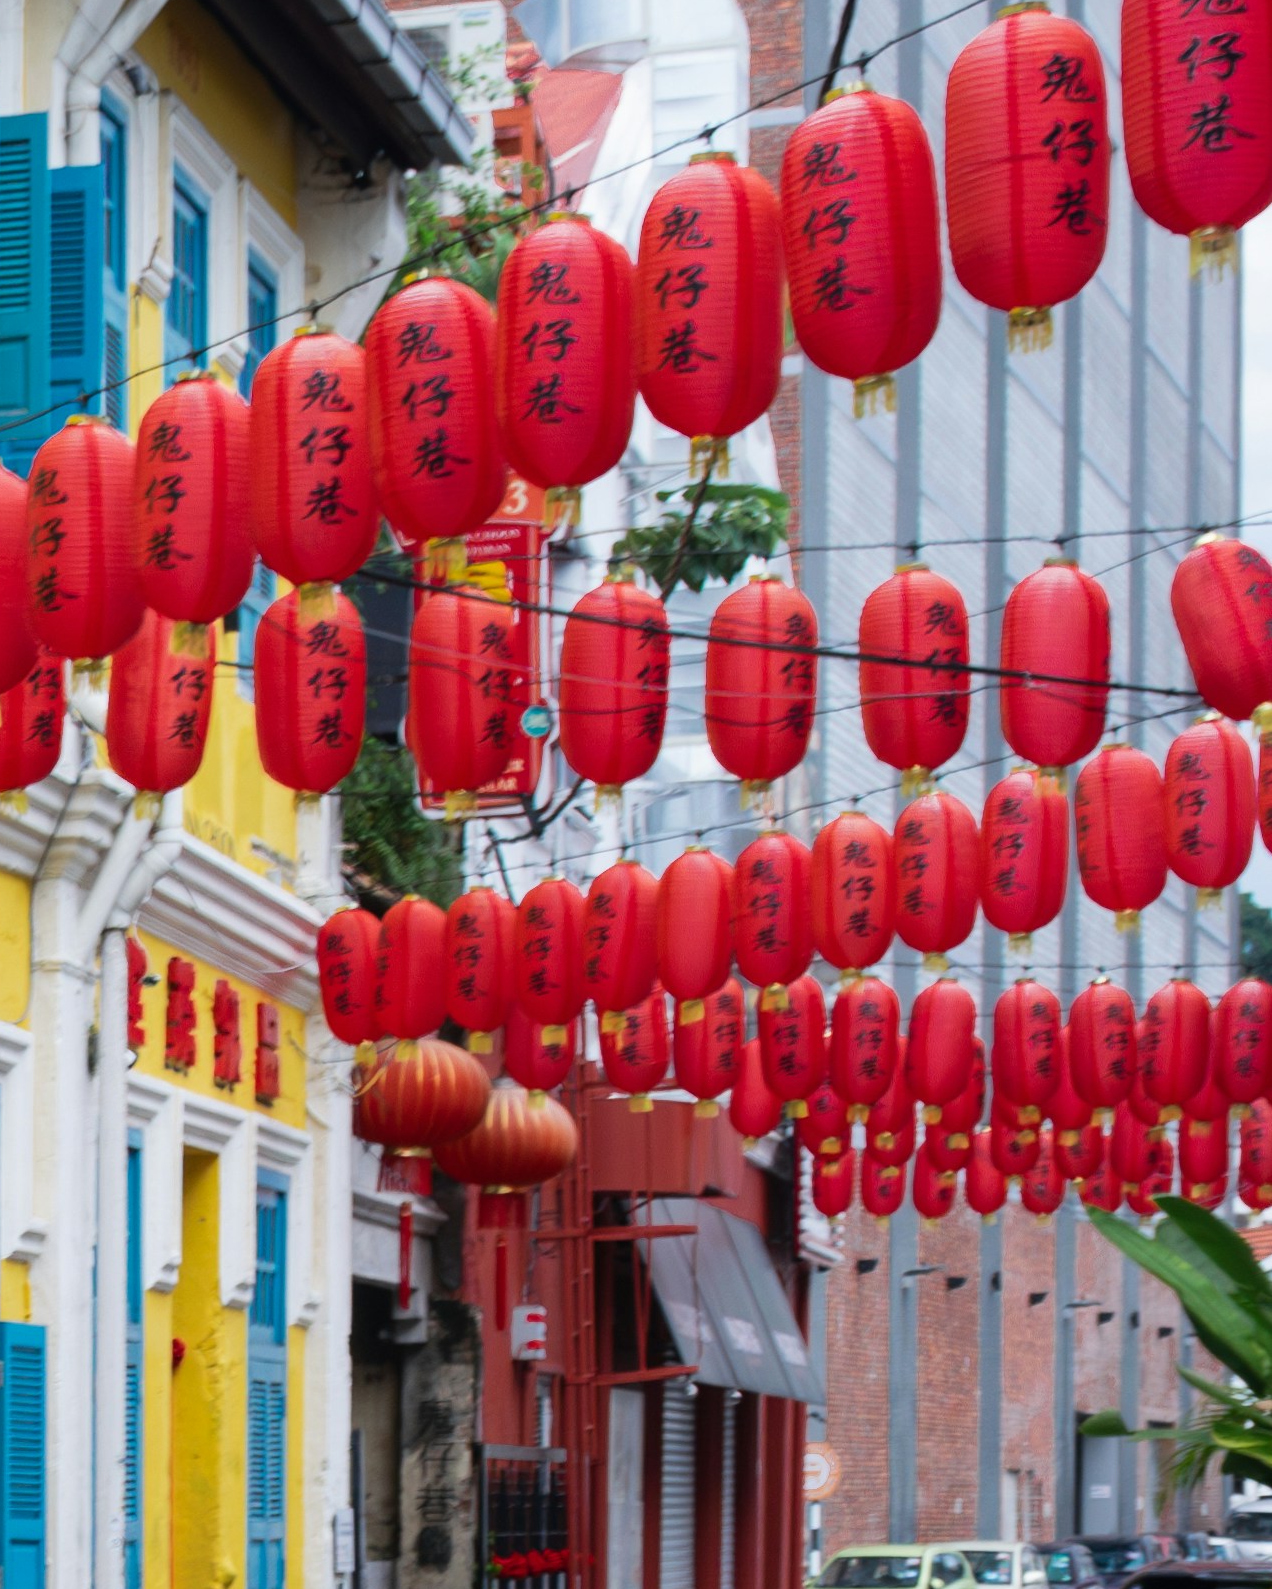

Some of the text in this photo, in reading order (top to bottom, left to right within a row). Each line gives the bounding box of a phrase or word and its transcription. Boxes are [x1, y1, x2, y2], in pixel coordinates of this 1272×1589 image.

[1038, 52, 1109, 237] 鬼仔巷
[656, 202, 720, 378] 鬼仔巷
[801, 139, 875, 316] 鬼仔巷
[395, 318, 474, 484] 鬼仔巷
[522, 259, 582, 429] 鬼仔巷
[143, 418, 199, 576] 鬼仔巷
[298, 366, 361, 527] 鬼仔巷
[31, 466, 80, 614] 鬼仔巷
[307, 620, 354, 749] 鬼仔巷
[475, 622, 513, 749] 鬼仔巷
